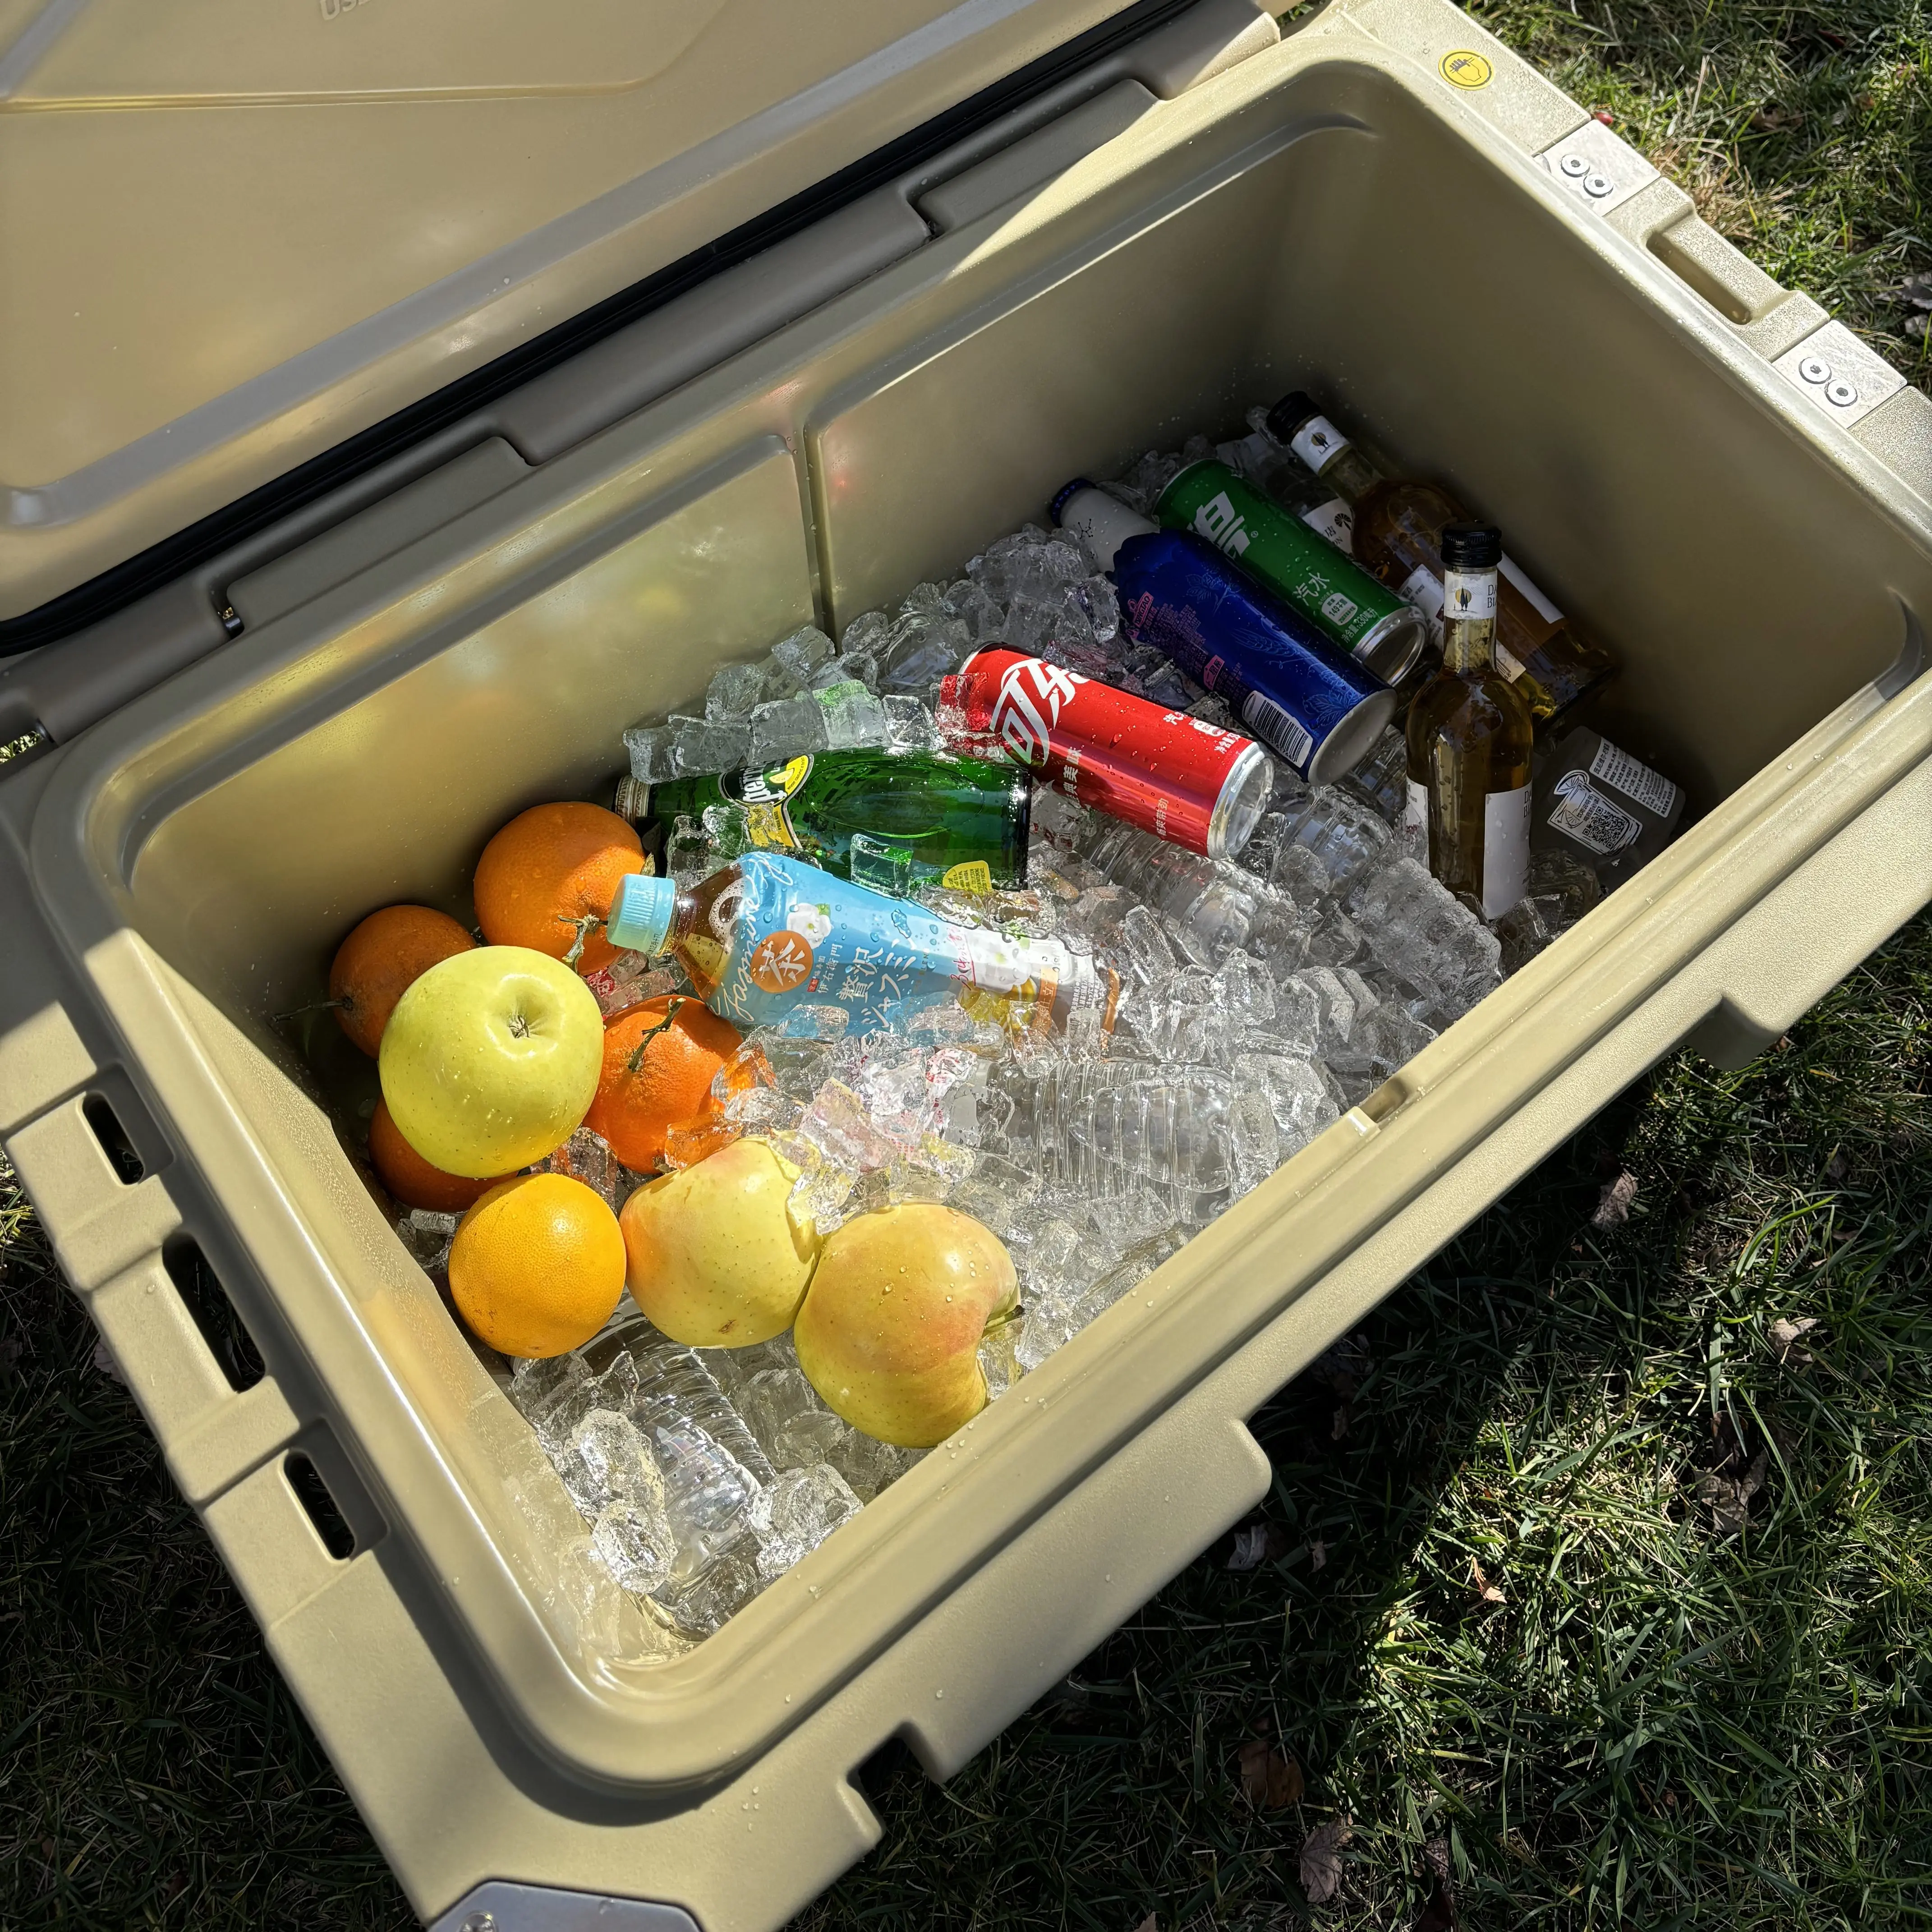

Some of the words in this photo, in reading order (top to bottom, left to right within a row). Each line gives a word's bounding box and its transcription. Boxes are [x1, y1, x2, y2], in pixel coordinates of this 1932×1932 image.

[1292, 571, 1330, 606] 汽水
[1487, 597, 1496, 607] BI
[988, 658, 1090, 766] 可乐
[741, 763, 787, 800] perri
[759, 938, 806, 985] 茶
[837, 946, 883, 1003] 贅沢
[861, 928, 916, 1028] ジャスミン
